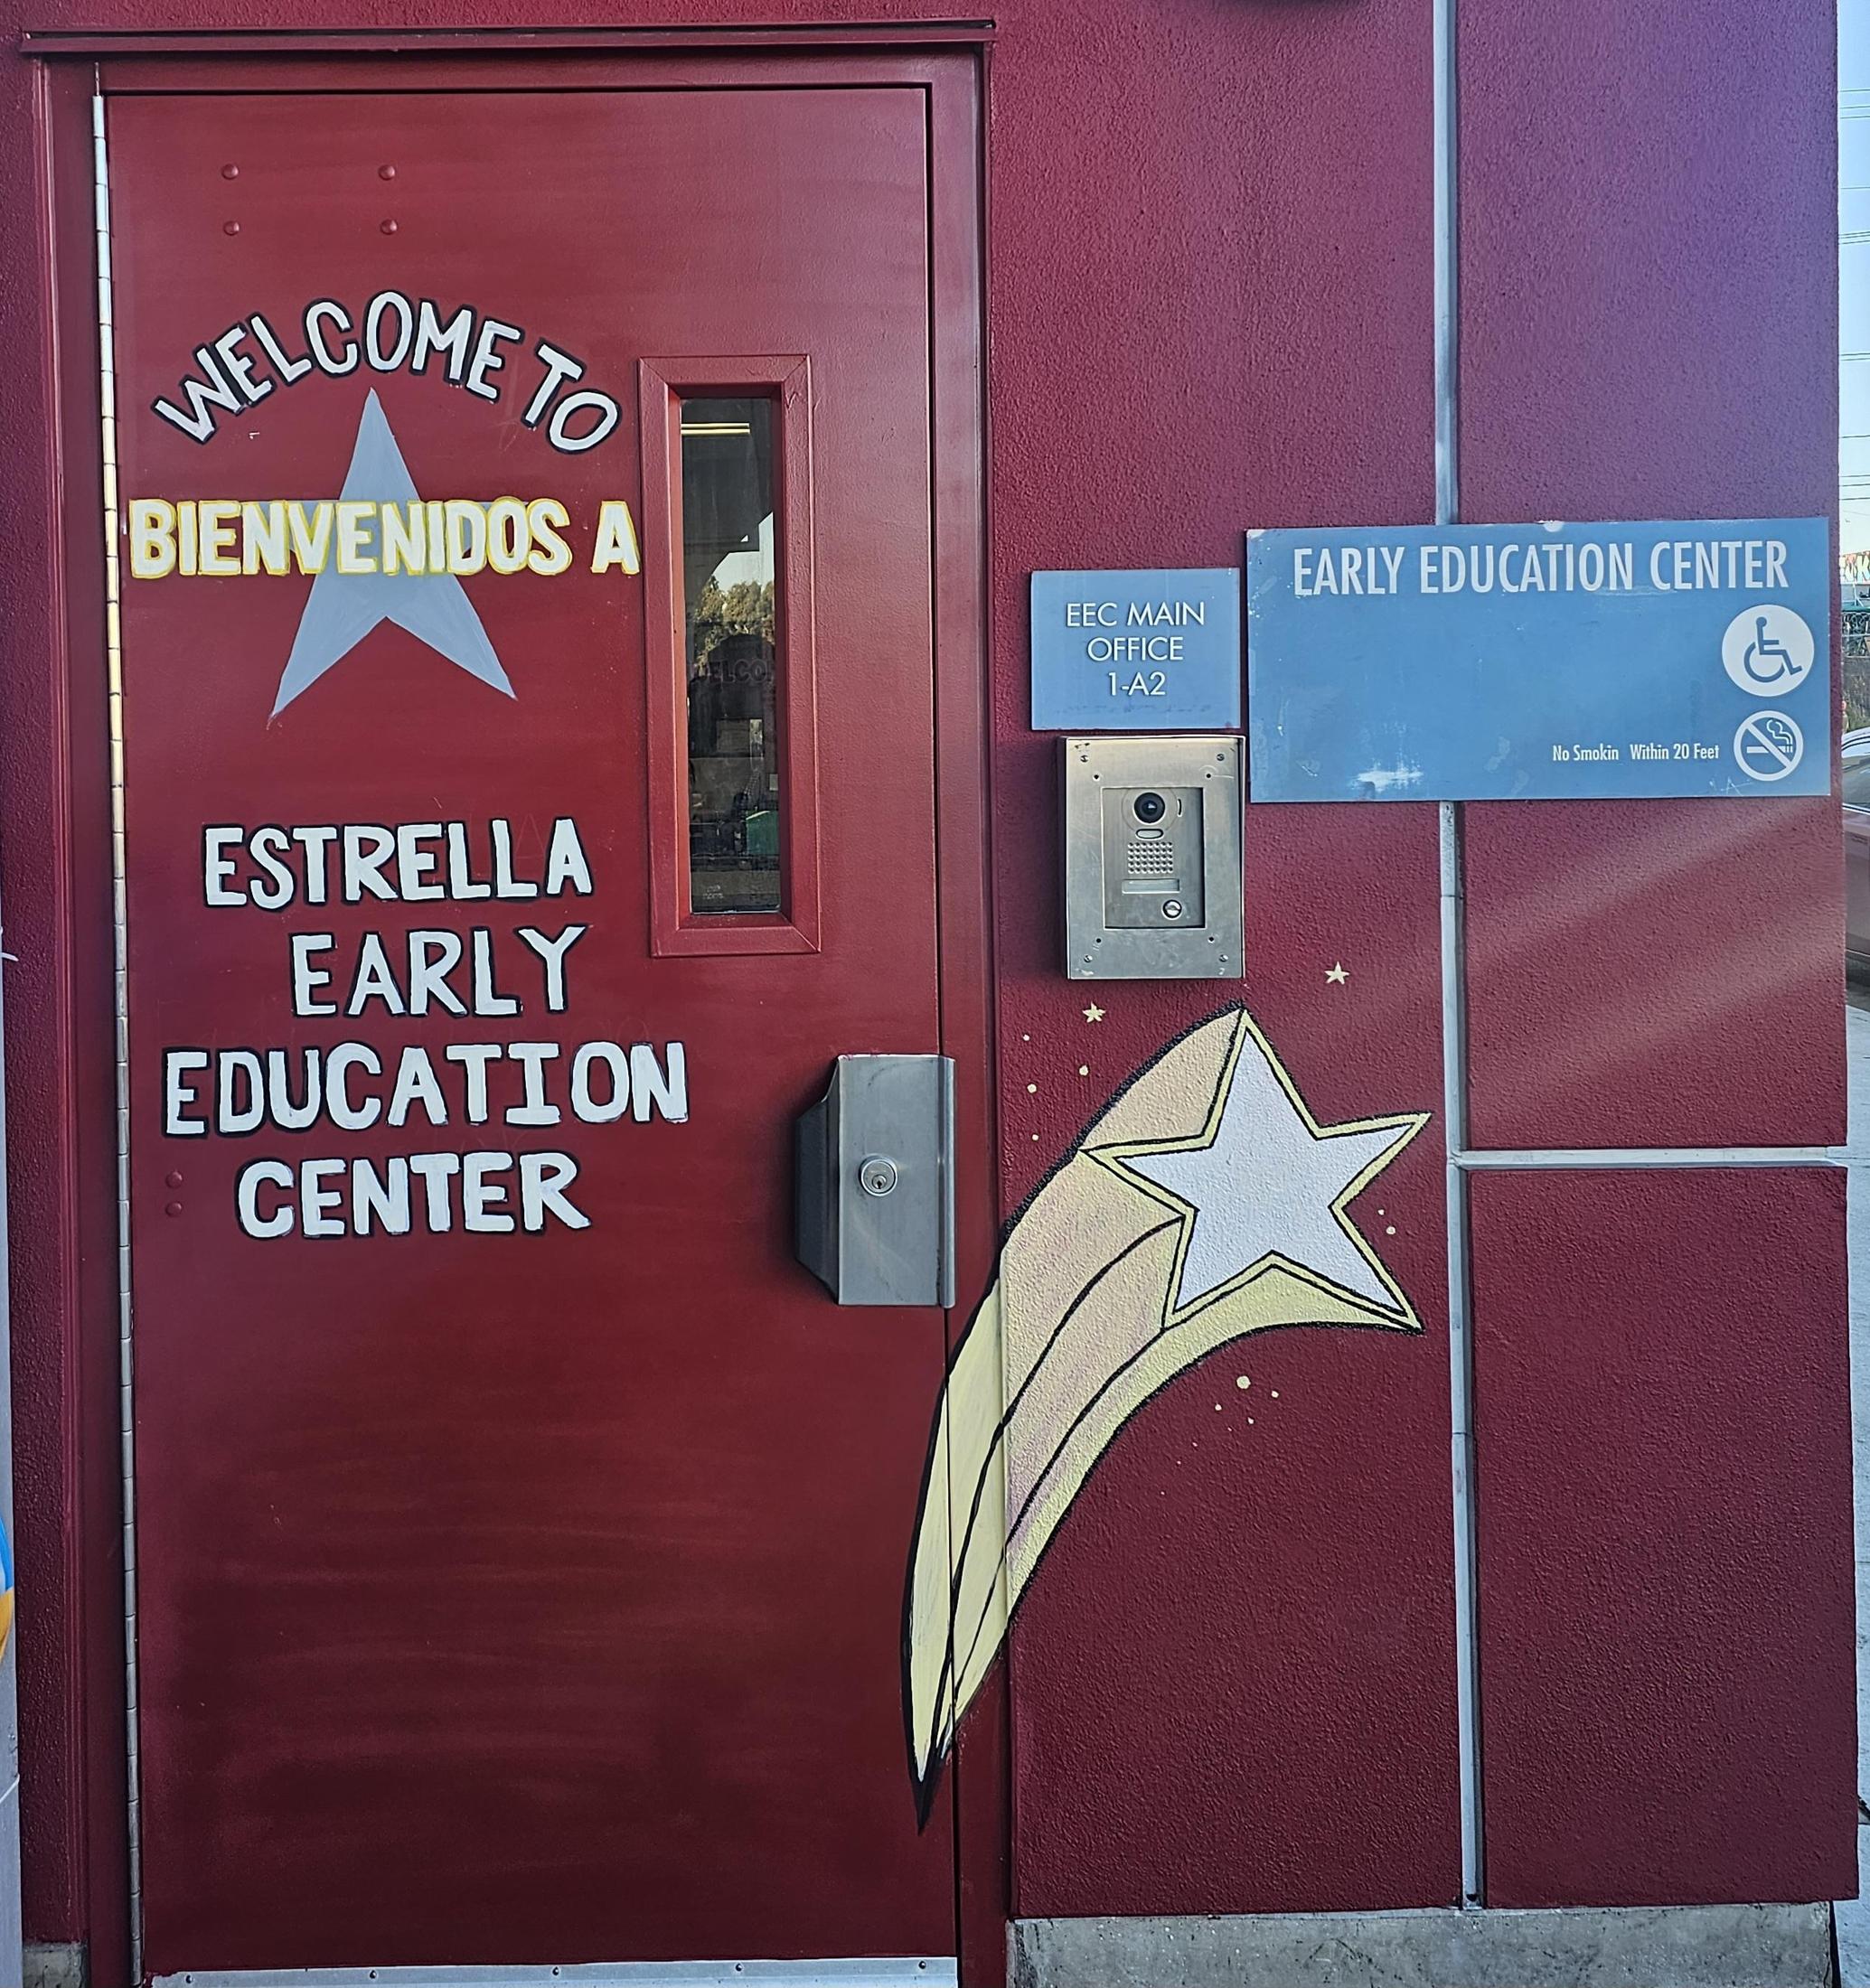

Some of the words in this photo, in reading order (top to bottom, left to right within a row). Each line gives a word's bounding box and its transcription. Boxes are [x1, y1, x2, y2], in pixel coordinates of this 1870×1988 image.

[153, 289, 522, 444] WELCOME
[522, 342, 621, 452] TO
[128, 497, 573, 578] BIENVENIDOS
[590, 500, 641, 575] A
[1293, 545, 1405, 596] EARLY
[1420, 542, 1633, 595] EDUCATION
[1649, 540, 1790, 591] CENTER
[1067, 602, 1118, 627] EEC
[1127, 601, 1205, 626] MAIN
[1087, 636, 1184, 661] OFFICE
[1108, 671, 1166, 696] 1-A2
[1552, 745, 1570, 761] No
[1630, 742, 1669, 760] Within
[1673, 743, 1690, 760] 20
[1693, 743, 1720, 760] Feet
[203, 817, 593, 910] ESTRELLA
[290, 925, 587, 1017] EARLY
[164, 1040, 690, 1136] EDUCATION
[236, 1150, 592, 1239] CENTER
